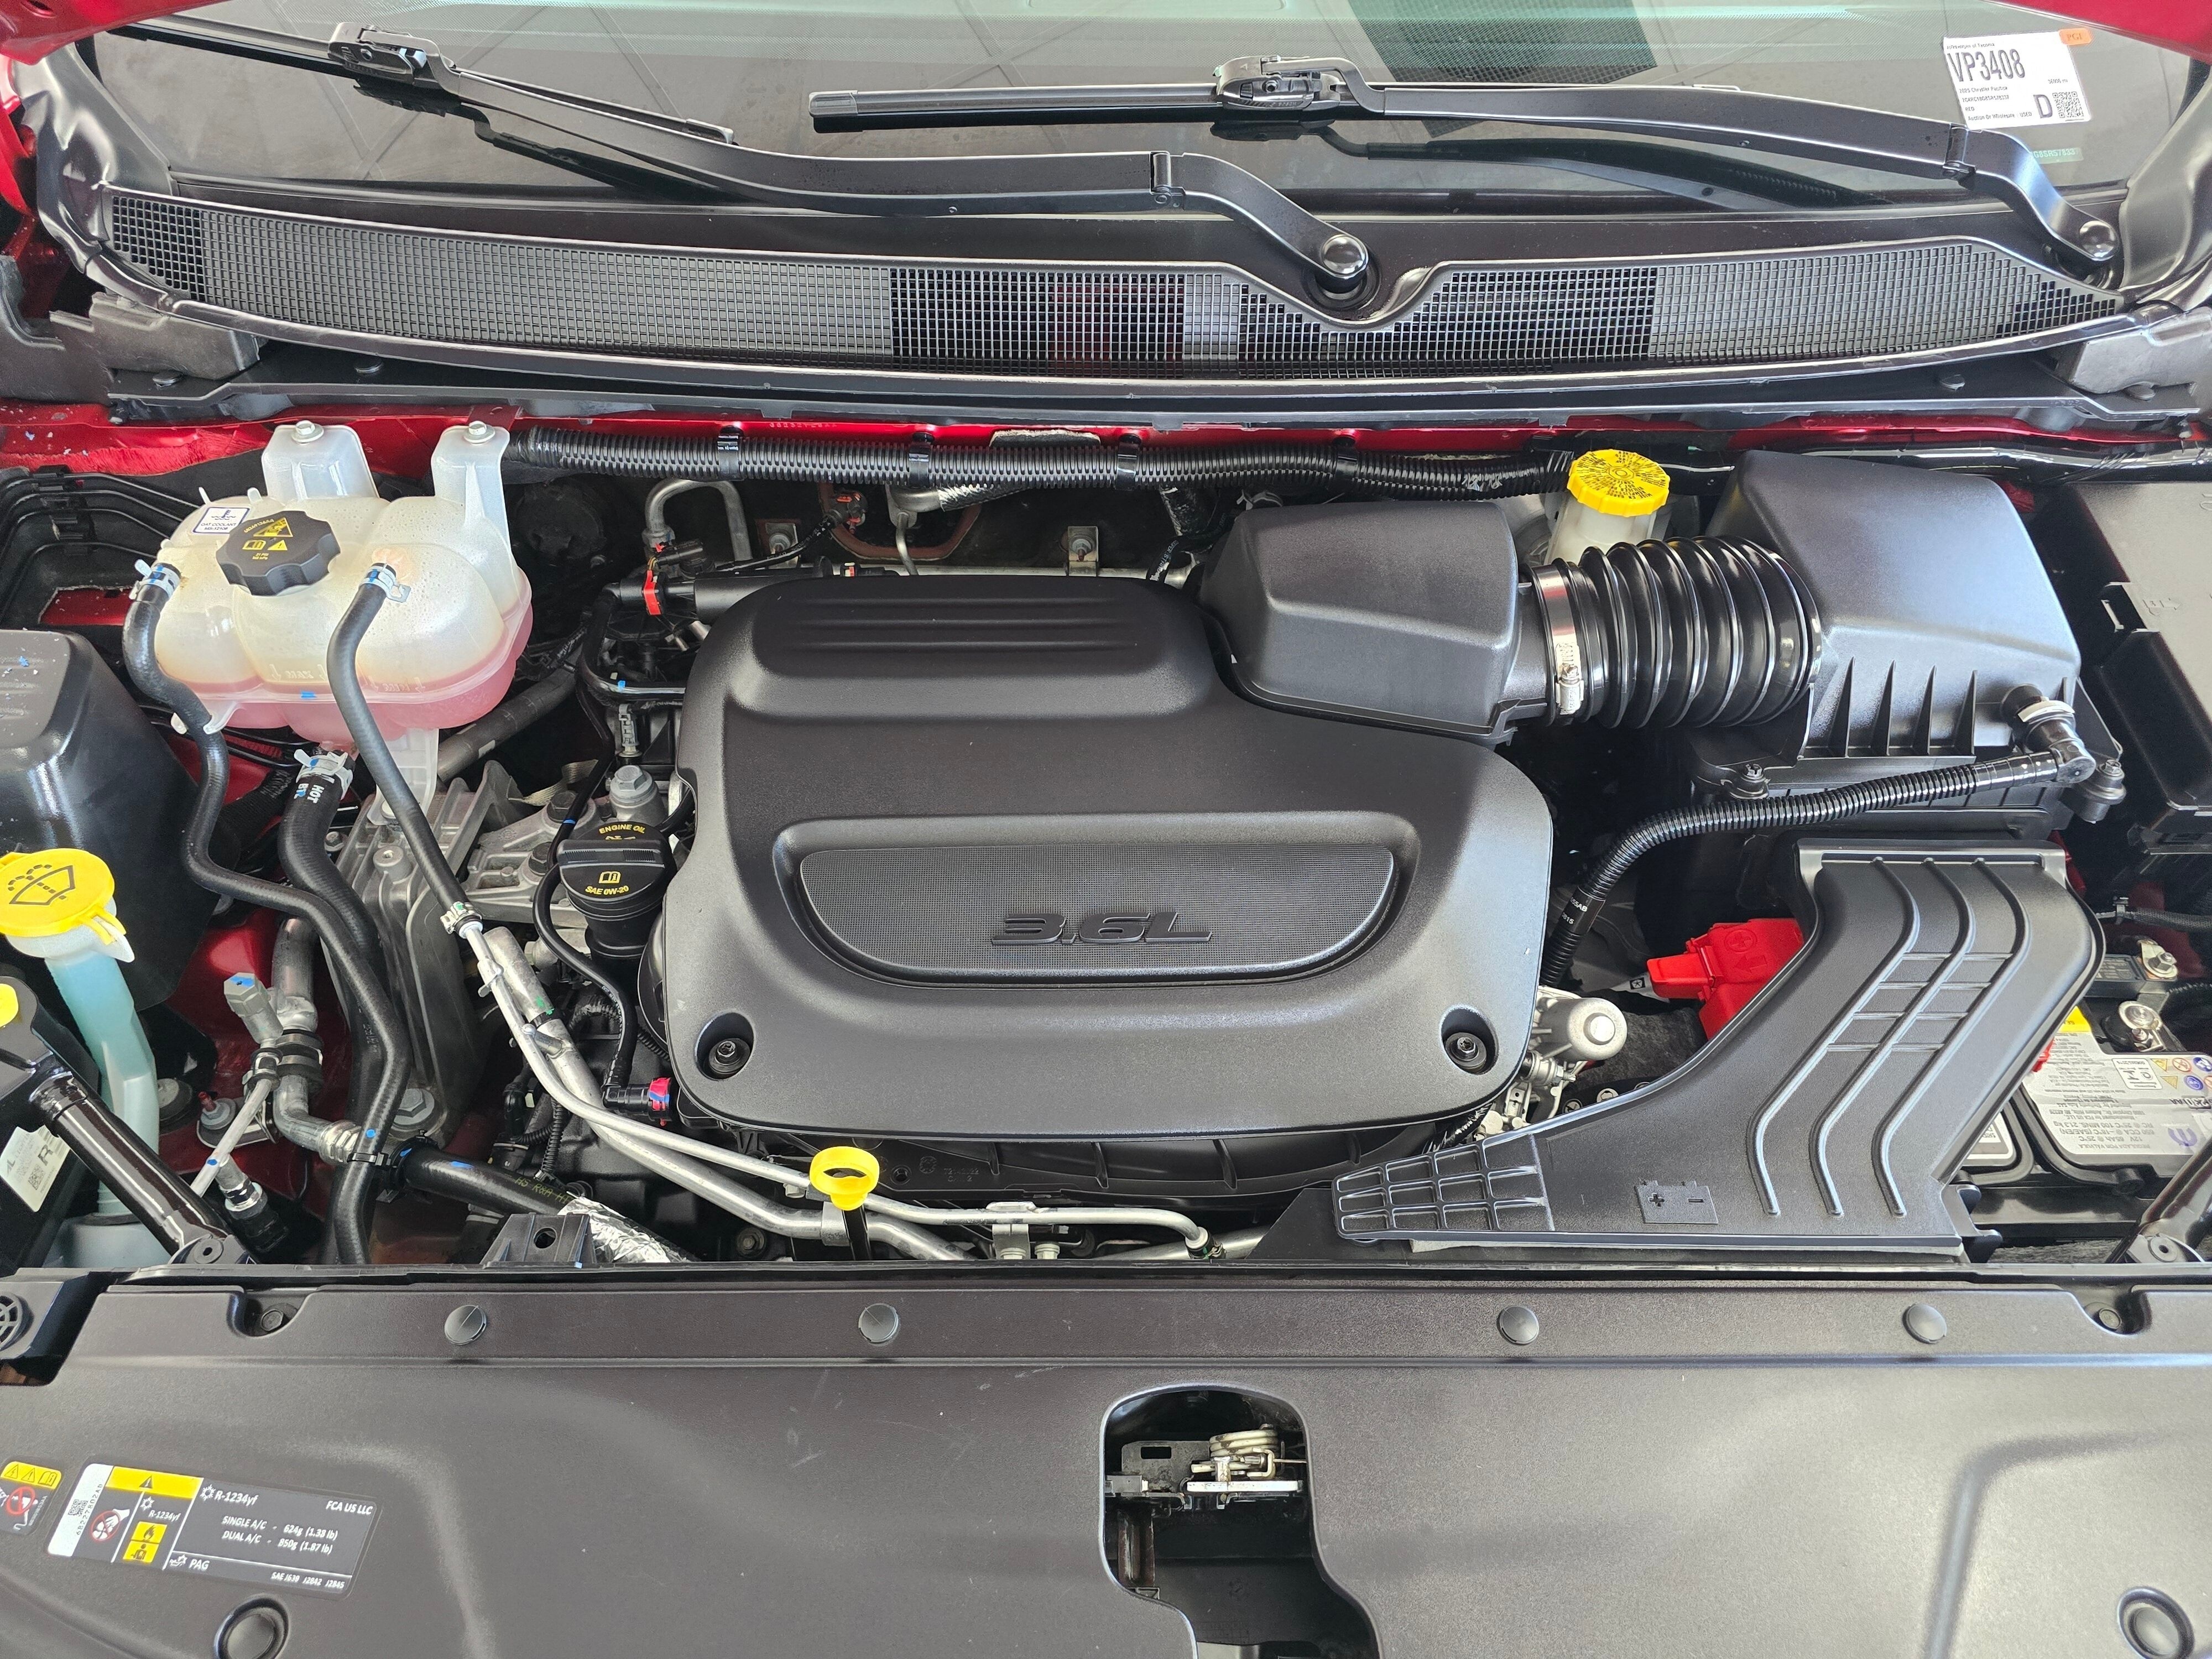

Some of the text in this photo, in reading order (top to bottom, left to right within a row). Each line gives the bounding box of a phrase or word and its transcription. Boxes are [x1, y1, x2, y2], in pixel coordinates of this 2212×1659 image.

[1947, 49, 2026, 82] VP3408
[2033, 94, 2053, 119] D
[307, 784, 325, 804] HOT
[599, 825, 632, 834] ENGINE
[585, 885, 629, 895] SAE 0W-20
[992, 911, 1213, 946] 3.6L
[38, 1144, 54, 1166] R
[214, 1490, 259, 1506] R-1234yf
[148, 1510, 181, 1522] R-1234yf
[326, 1500, 373, 1515] FCA US LLC
[221, 1515, 251, 1526] SINGLE
[251, 1520, 267, 1530] A/C
[283, 1524, 303, 1537] 624g
[305, 1526, 327, 1537] (1.38
[326, 1530, 338, 1541] lb)
[221, 1530, 244, 1541] DUAL
[245, 1533, 262, 1543] A/C
[277, 1538, 299, 1551] 850g
[299, 1541, 321, 1552] (1.87
[321, 1543, 333, 1554] lb)
[189, 1558, 210, 1570] PAG
[270, 1572, 285, 1580] SAE
[285, 1574, 300, 1583] J639
[302, 1576, 322, 1586] J2842
